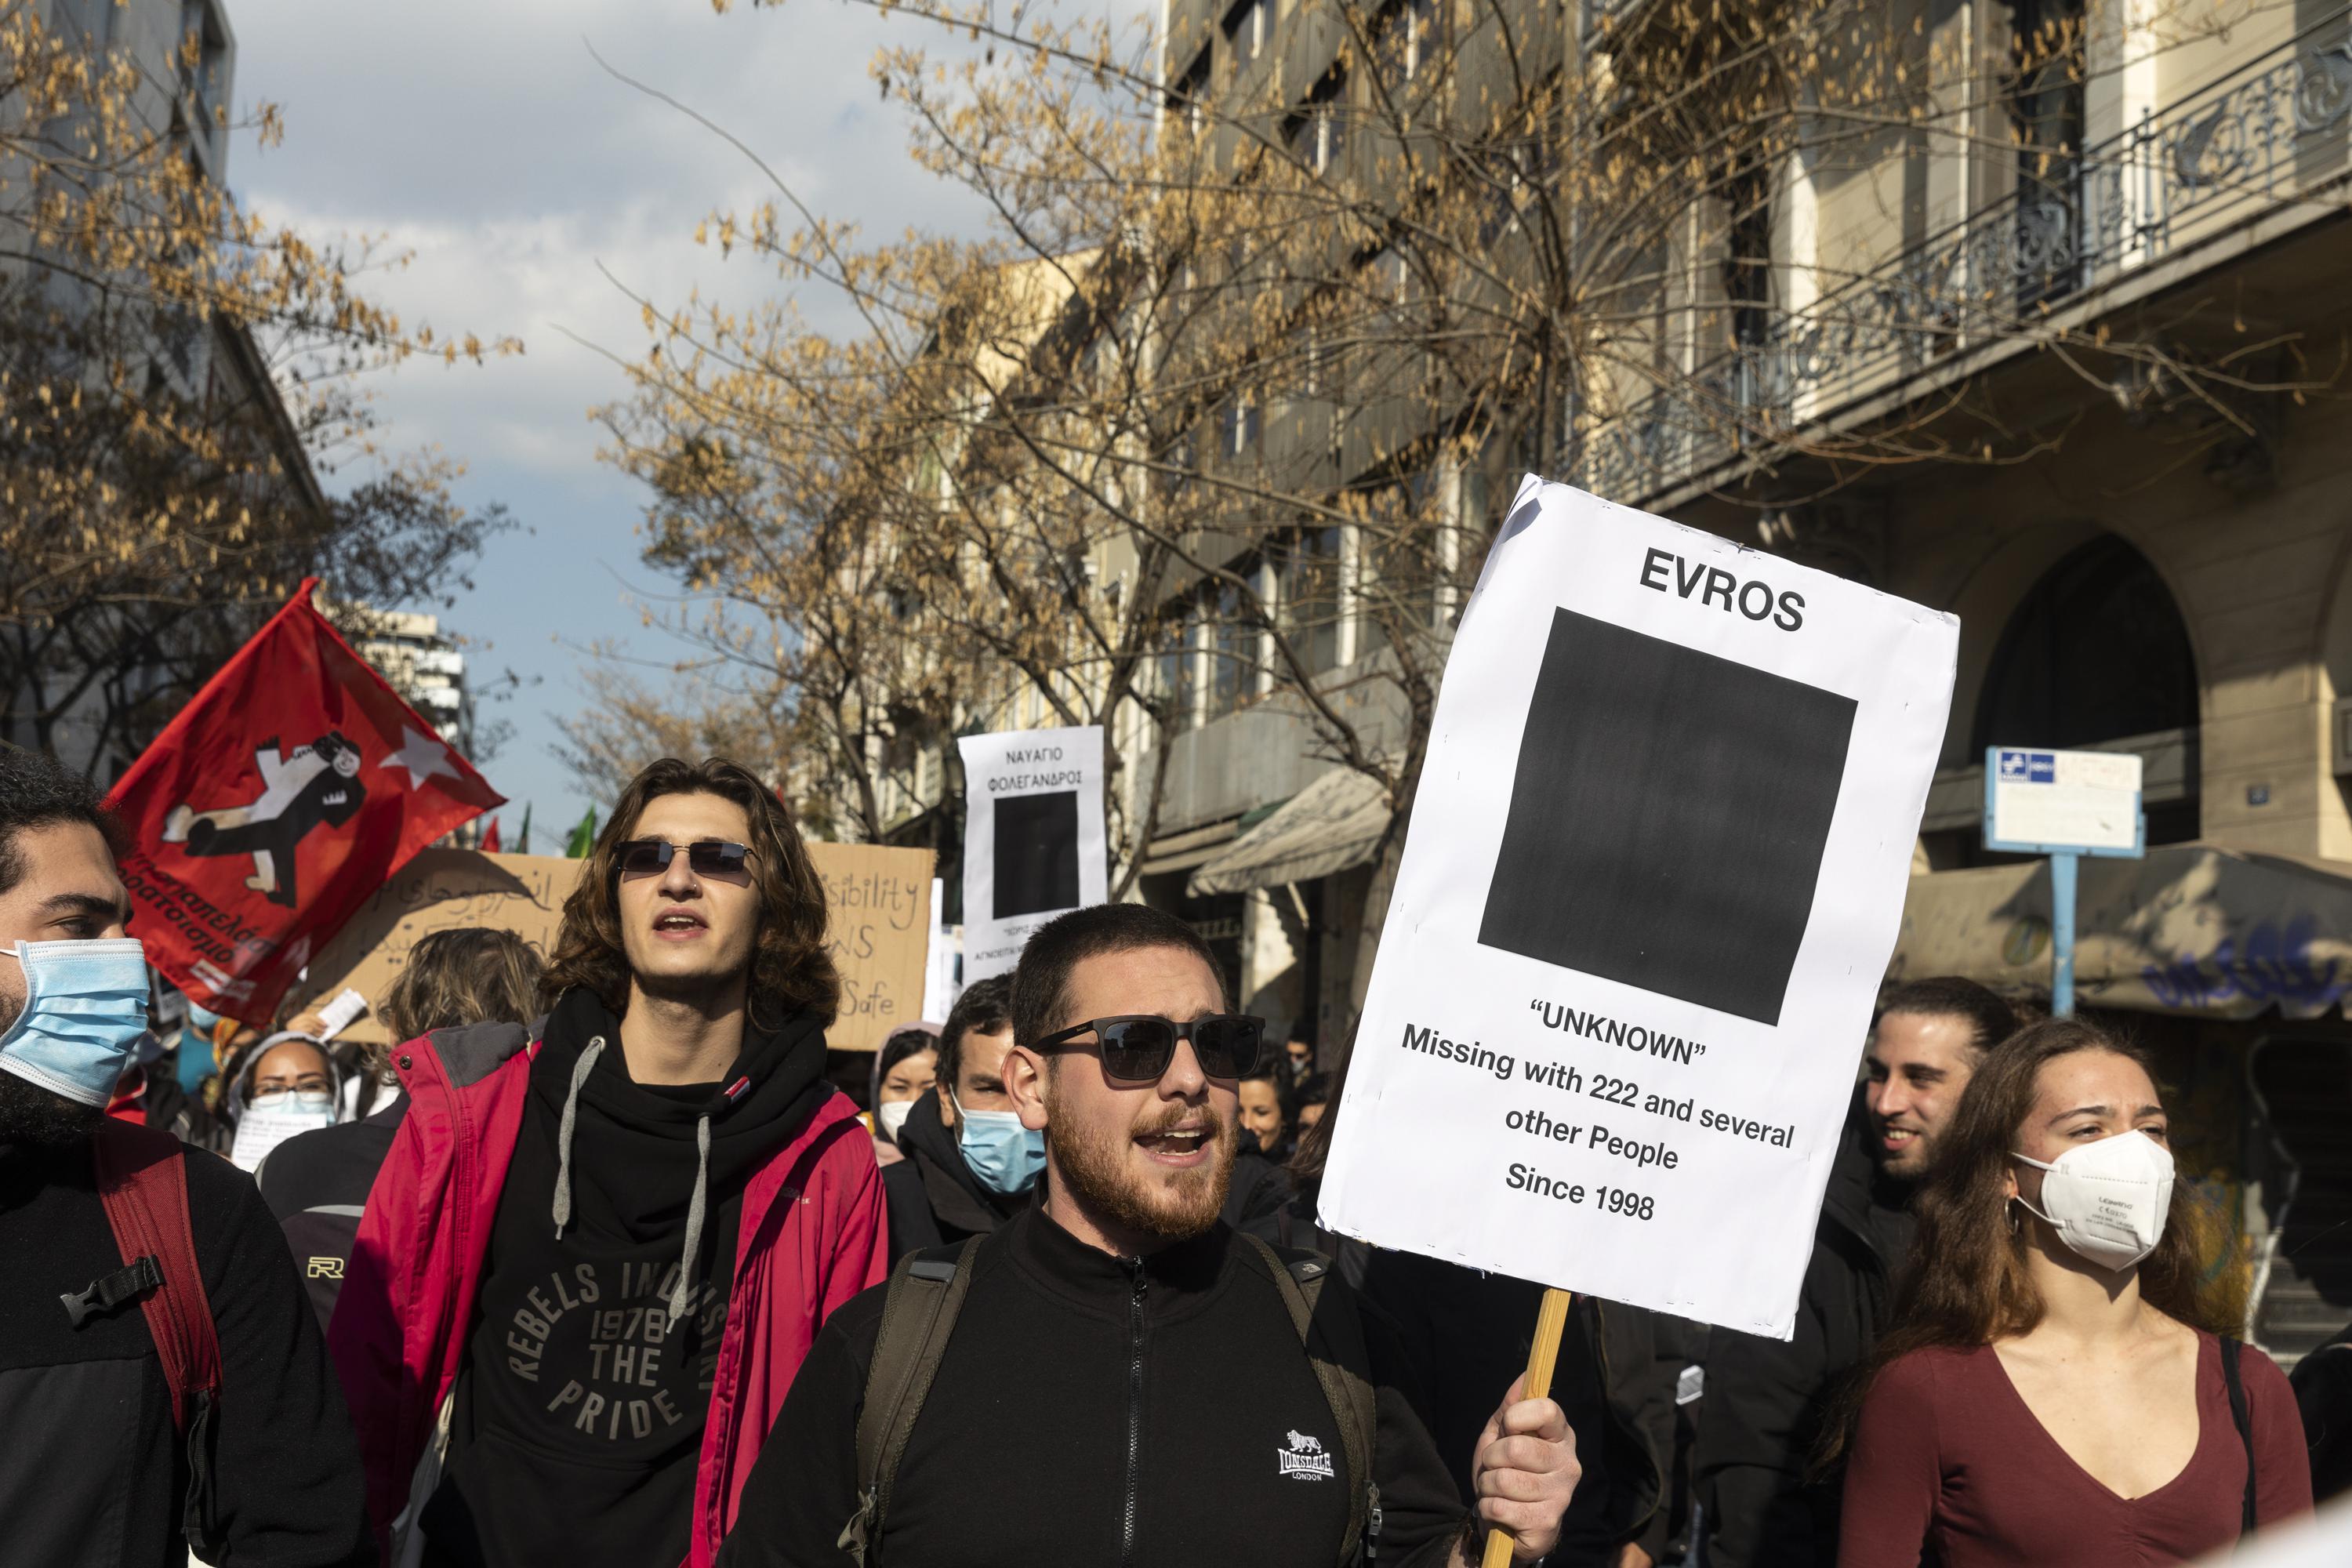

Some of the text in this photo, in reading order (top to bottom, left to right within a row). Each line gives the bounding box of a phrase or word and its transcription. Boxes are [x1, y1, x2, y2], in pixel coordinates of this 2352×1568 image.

[1639, 546, 1806, 632] EVROS
[988, 770, 1083, 792] ΦΟΛΕΓΑΝΔΡΟΣ
[1006, 746, 1063, 764] ΝΑΥΑΓΙΟ
[826, 872, 918, 931] sibility
[839, 979, 895, 1019] Safe
[1530, 999, 1707, 1065] “UNKNOWN”
[1401, 1022, 1795, 1149] Missing with 222 and several
[1505, 1109, 1679, 1170] other People
[1505, 1162, 1655, 1221] Since 1998
[506, 1263, 601, 1382] REBELS
[590, 1307, 666, 1344] 1978
[589, 1344, 662, 1387] THE
[546, 1379, 684, 1440] PRIDE
[1277, 1448, 1335, 1477] LONSDALE
[1292, 1472, 1323, 1482] LONDON
